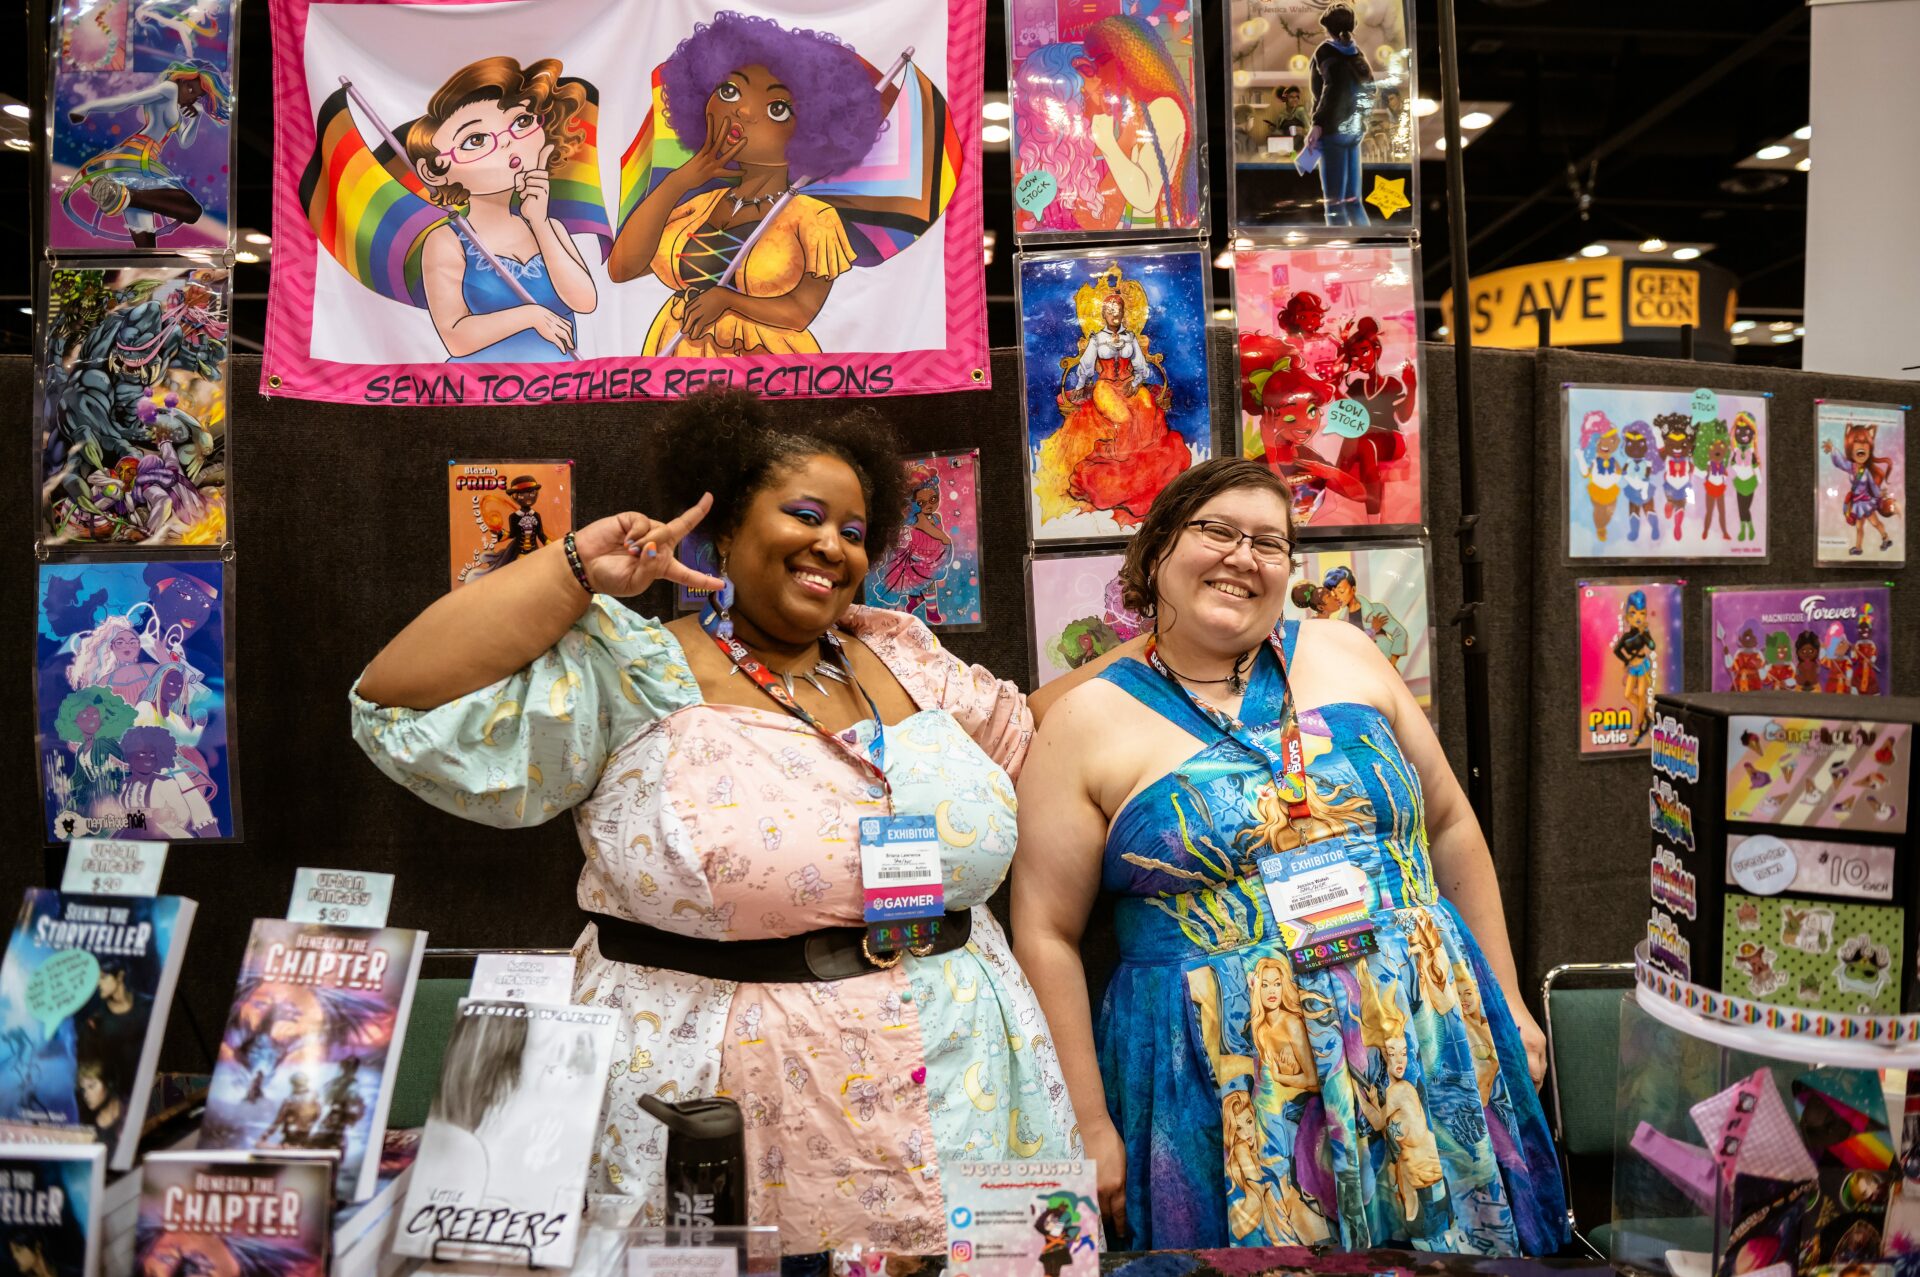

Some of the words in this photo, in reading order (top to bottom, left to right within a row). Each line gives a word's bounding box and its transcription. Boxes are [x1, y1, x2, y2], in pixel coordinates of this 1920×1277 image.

[1019, 175, 1037, 192] LOW
[1022, 181, 1051, 205] STOCK
[1635, 273, 1694, 296] GEN
[1473, 288, 1504, 333] S'
[1512, 275, 1607, 327] AVE
[1635, 299, 1694, 320] CON
[364, 374, 465, 404] SEWN
[478, 367, 652, 403] TOGETHER
[1696, 391, 1711, 400] LOW
[1338, 401, 1363, 417] LOW
[1691, 402, 1716, 411] STOCK
[1330, 410, 1365, 431] STOCK
[456, 475, 507, 490] PRIDE
[464, 466, 497, 476] Blazing
[1762, 613, 1804, 622] MAGNIFIQUE
[1800, 595, 1858, 622] Forever
[1150, 651, 1168, 677] BOYS
[1591, 729, 1629, 745] tastic
[1288, 739, 1302, 774] BOYS
[888, 827, 935, 840] EXHIBITOR
[1290, 849, 1345, 873] EXHIBITOR
[884, 894, 934, 909] GAYMER
[1315, 911, 1365, 930] GAYMER
[35, 914, 152, 956] STORYTELLER
[295, 934, 344, 952] BENEATH
[346, 938, 368, 953] THE
[1294, 934, 1373, 963] SPONSOR
[263, 942, 388, 990] CHAPTER
[463, 1003, 535, 1019] JESSICA
[539, 1008, 611, 1026] WALSH
[195, 1173, 249, 1192] BENEATH
[252, 1176, 275, 1193] THE
[0, 1185, 64, 1226] ELLER
[164, 1185, 300, 1236] CHAPTER
[405, 1204, 568, 1247] CREEPERS
